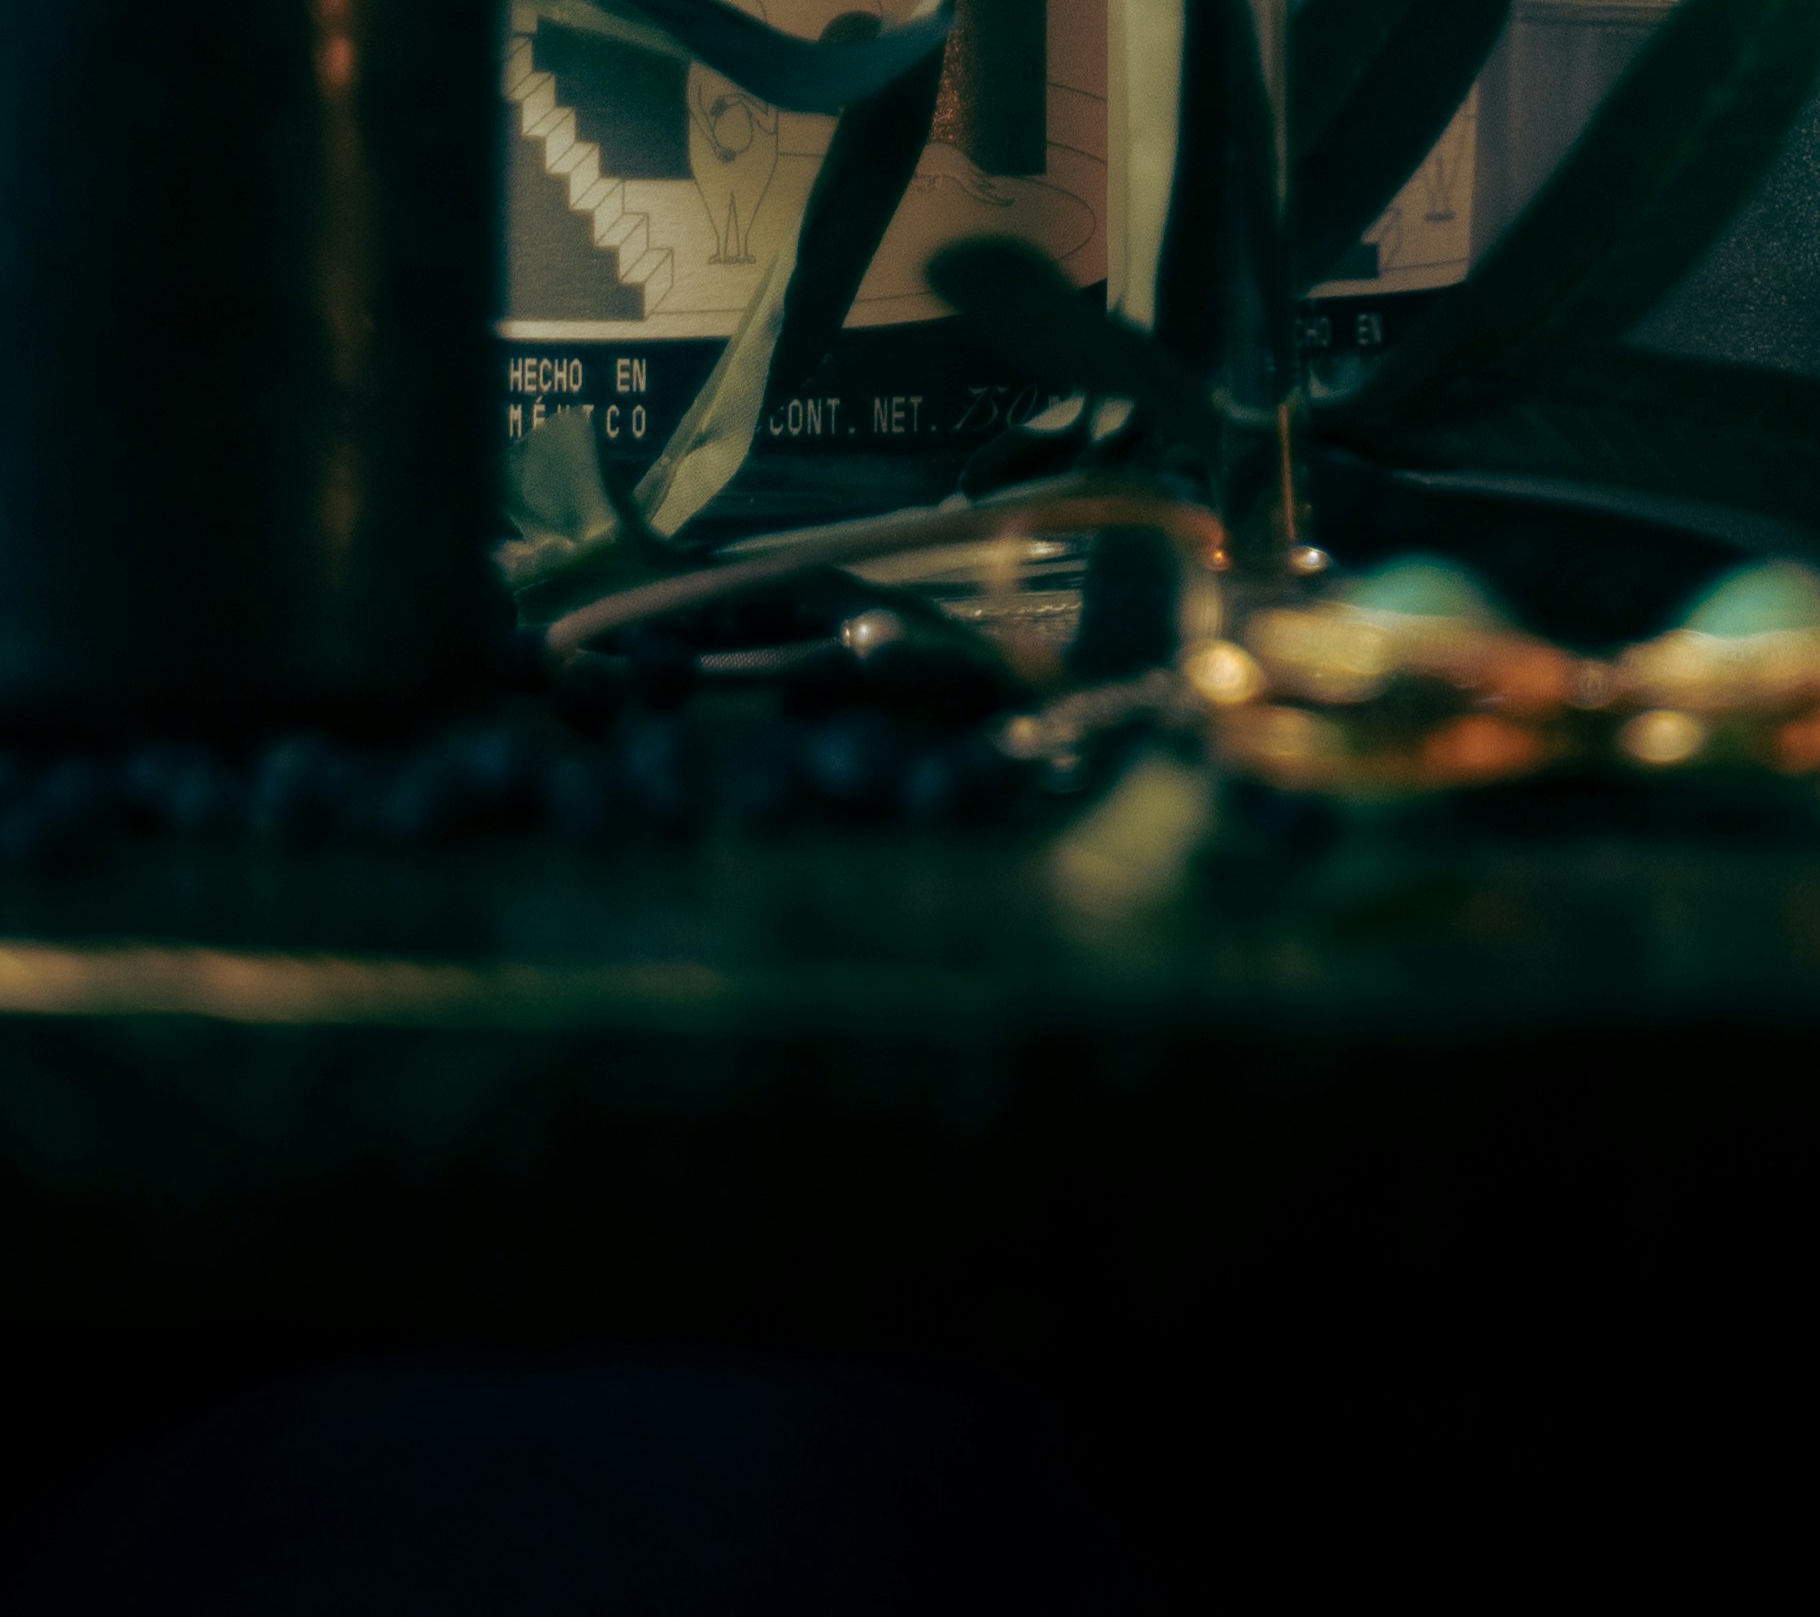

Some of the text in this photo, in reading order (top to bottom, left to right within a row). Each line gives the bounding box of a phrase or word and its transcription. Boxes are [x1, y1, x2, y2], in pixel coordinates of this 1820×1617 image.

[508, 356, 648, 395] HECHO EN
[507, 396, 648, 440] MÉCO
[873, 395, 938, 434] NET.
[952, 382, 1062, 433] 750
